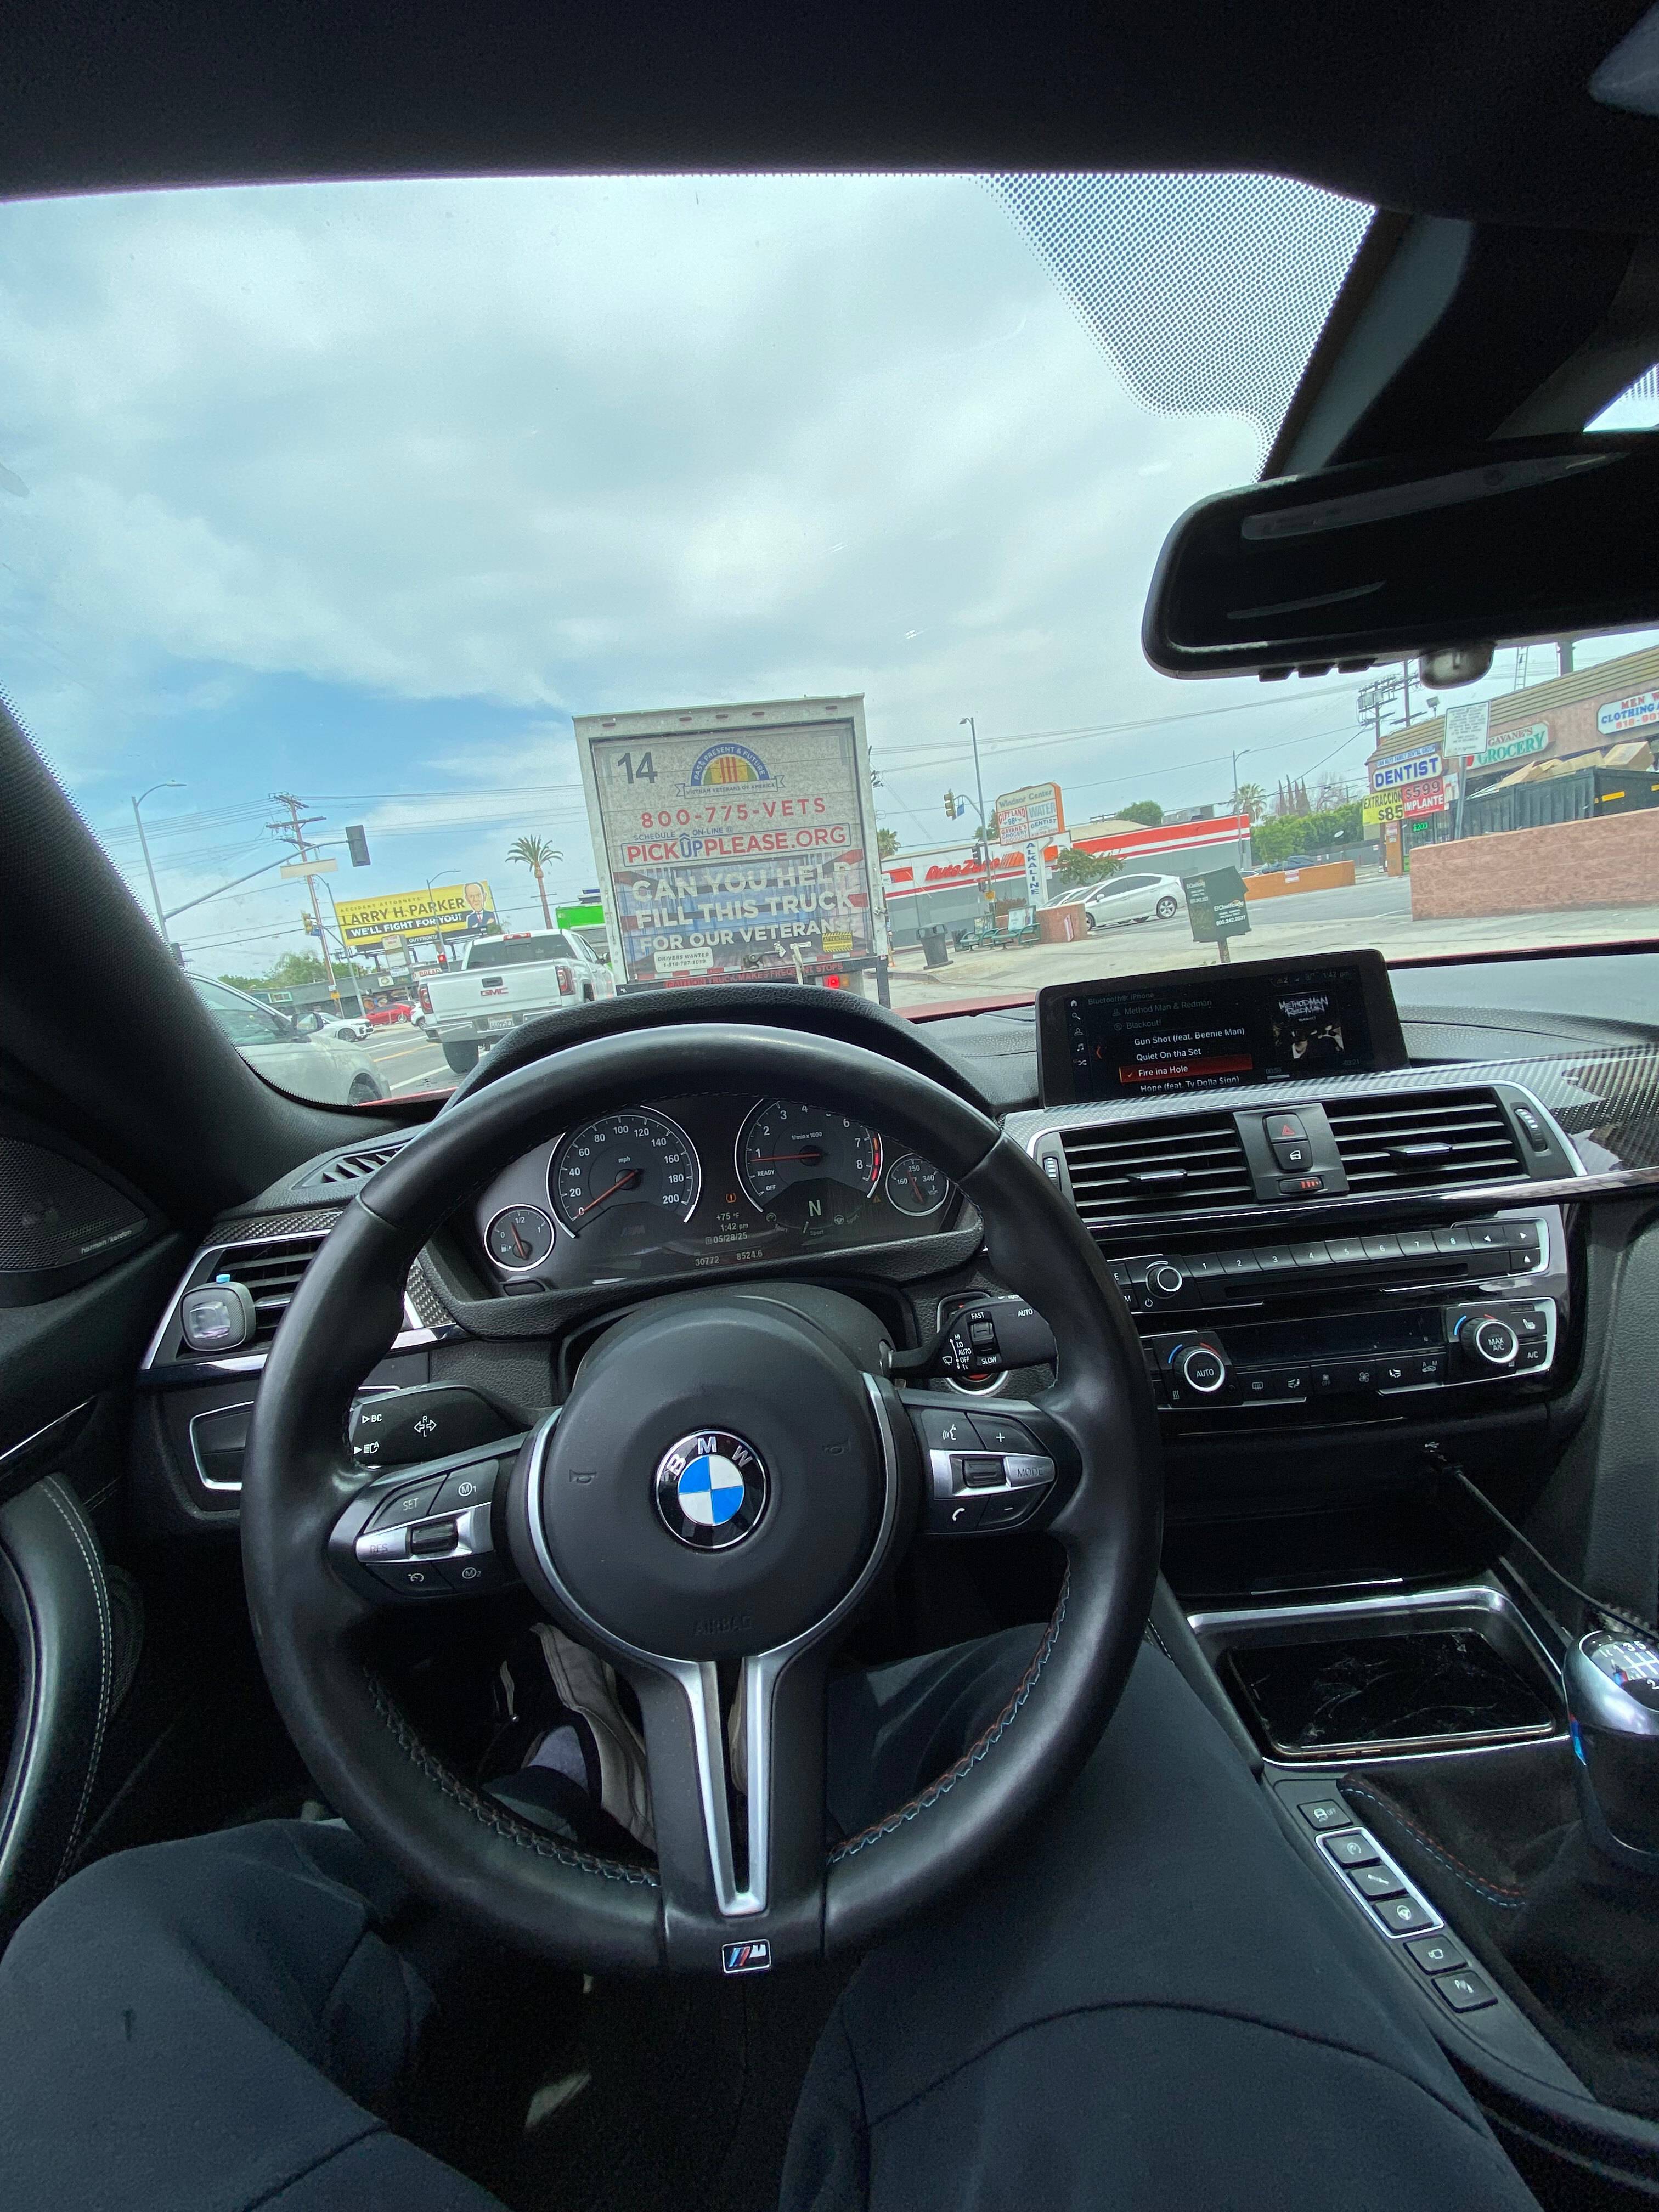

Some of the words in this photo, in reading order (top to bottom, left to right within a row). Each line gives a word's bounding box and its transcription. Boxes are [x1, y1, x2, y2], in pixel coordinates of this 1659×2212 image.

[1621, 696, 1645, 709] MEN
[1601, 703, 1655, 724] CLOTHING
[1488, 727, 1533, 747] GAYANE'S
[1477, 731, 1545, 765] GROCERY
[704, 747, 735, 761] PRESENT
[742, 751, 765, 775] FUTURE
[618, 752, 658, 785] 14
[1375, 757, 1438, 787] DENTIST
[1406, 781, 1440, 799] $599
[999, 797, 1026, 808] Windsor
[1029, 790, 1052, 800] Center
[1364, 788, 1403, 809] EXTRACCION
[1404, 794, 1444, 811] IMPLANTE
[641, 797, 826, 828] 800-775-VETS
[1029, 802, 1056, 818] WATER
[1378, 805, 1403, 821] $85
[998, 812, 1010, 825] GIFT
[1012, 808, 1026, 818] LAND
[1031, 819, 1057, 828] DENTIST
[1001, 824, 1027, 834] GAYANE'S
[634, 832, 675, 842] SCHEDULE
[692, 827, 723, 836] ON-LINE
[1002, 830, 1027, 839] GROCERY
[1002, 835, 1028, 843] PRODUCE
[1026, 842, 1040, 895] ALKALINE
[632, 876, 698, 902] CAN
[704, 869, 768, 895] YOU
[777, 862, 851, 889] HELP
[341, 904, 375, 912] ACCIDENT
[342, 909, 389, 926] LARRY
[393, 906, 407, 918] H.
[410, 898, 466, 916] PARKER
[635, 906, 693, 929] FILL
[697, 900, 759, 923] THIS
[764, 890, 854, 916] TRUCK
[351, 925, 382, 937] WE'LL
[384, 921, 413, 932] FIGHT
[416, 917, 436, 927] FOR
[439, 913, 462, 923] YOU!
[640, 934, 684, 953] FOR
[690, 930, 735, 947] OUR
[665, 977, 706, 988] CAUTION
[708, 974, 737, 985] TRUCK
[737, 971, 769, 981] MAKES
[816, 963, 843, 973] STOPS
[481, 988, 509, 996] GMC
[1130, 992, 1154, 1001] iPhone
[1124, 1006, 1153, 1015] Method
[1155, 1005, 1171, 1013] Man
[1173, 1002, 1180, 1011] &
[1181, 1000, 1212, 1008] Redman
[1126, 1019, 1163, 1029] Blackout!
[1135, 1037, 1151, 1046] Gun
[1153, 1036, 1171, 1044] Shot
[1172, 1034, 1193, 1043] (feat.
[1195, 1030, 1223, 1040] Beenie
[1224, 1027, 1245, 1037] Man)
[1136, 1052, 1158, 1062] Quiet
[1160, 1051, 1171, 1059] On
[1173, 1049, 1187, 1058] tha
[1188, 1048, 1202, 1057] Set
[1138, 1069, 1154, 1077] Fire
[1155, 1068, 1168, 1076] ina
[1170, 1065, 1188, 1074] Hole
[1141, 1084, 1162, 1093] Hope
[1164, 1081, 1183, 1091] (feat.
[1197, 1077, 1217, 1087] Dolla
[1218, 1075, 1240, 1085] Sign)
[780, 1110, 787, 1120] 3
[843, 1118, 850, 1128] 6
[613, 1125, 629, 1135] 100
[634, 1128, 650, 1137] 120
[763, 1126, 770, 1136] 2
[594, 1133, 606, 1143] 80
[651, 1137, 667, 1147] 140
[855, 1138, 861, 1148] 7
[579, 1147, 590, 1157] 60
[664, 1154, 680, 1164] 160
[856, 1159, 864, 1169] 8
[569, 1167, 581, 1176] 40
[668, 1173, 684, 1183] 180
[569, 1187, 582, 1197] 20
[662, 1194, 680, 1204] 200
[808, 1199, 822, 1217] N
[515, 1216, 526, 1224] 1/2
[716, 1212, 731, 1221] +75
[720, 1223, 737, 1232] 1:42
[714, 1232, 748, 1243] 05/28/25
[695, 1256, 719, 1266] 30772
[736, 1250, 763, 1260] 8524.6
[971, 1311, 985, 1319] FAST
[1018, 1308, 1034, 1317] AUTO
[1488, 1337, 1504, 1345] MAX
[1493, 1344, 1505, 1352] A/C
[981, 1356, 997, 1365] SLOW
[1197, 1369, 1214, 1378] AUTO
[371, 1414, 382, 1423] BC
[667, 1436, 753, 1480] BMW
[1017, 1467, 1043, 1477] MODE
[403, 1497, 419, 1510] SET
[370, 1543, 388, 1554] RES
